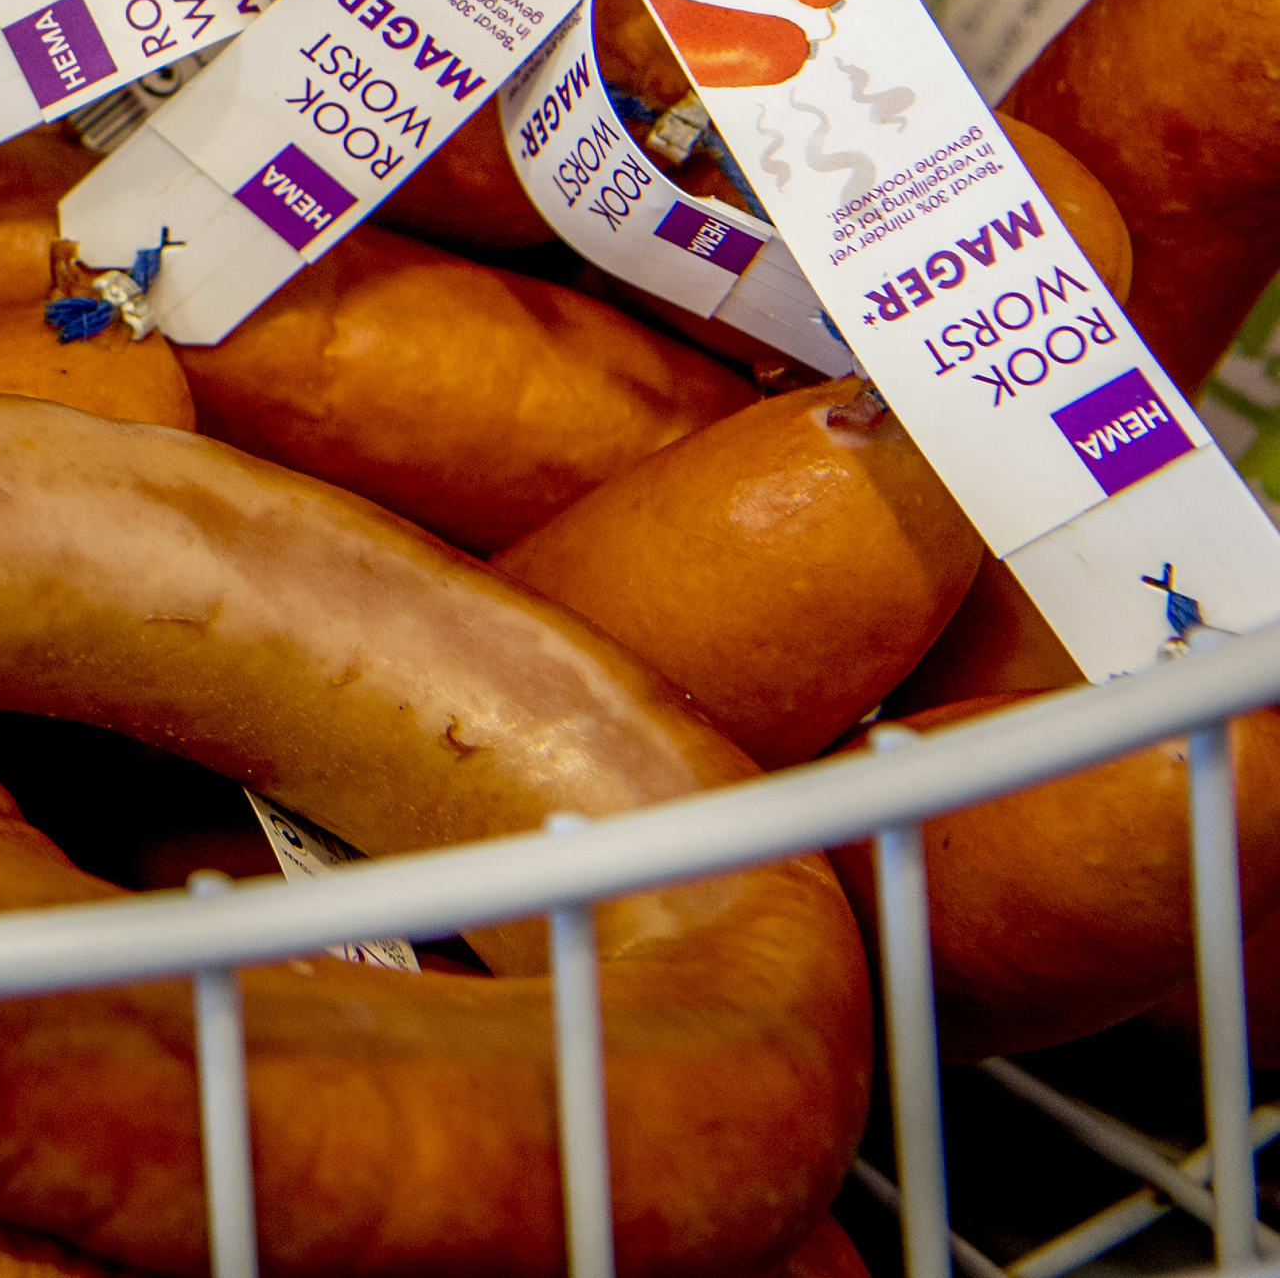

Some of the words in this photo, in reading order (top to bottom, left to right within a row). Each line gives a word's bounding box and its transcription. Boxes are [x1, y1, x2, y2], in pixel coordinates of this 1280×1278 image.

[36, 9, 86, 91] HEMA
[299, 33, 432, 150] WORST
[285, 77, 404, 180] ROOK
[914, 126, 983, 173] gewone
[552, 115, 620, 208] WORST
[881, 155, 976, 212] vergelijking
[261, 164, 333, 231] HEMA
[588, 153, 653, 233] ROOK
[827, 169, 914, 225] rookworst.
[857, 208, 884, 229] tot
[915, 189, 950, 214] 30%
[687, 218, 730, 258] HEMA
[829, 244, 858, 266] vet
[832, 223, 856, 241] de
[859, 208, 915, 249] minder
[924, 265, 1090, 376] WORST
[971, 306, 1119, 407] ROOK
[1075, 399, 1169, 460] HEMA
